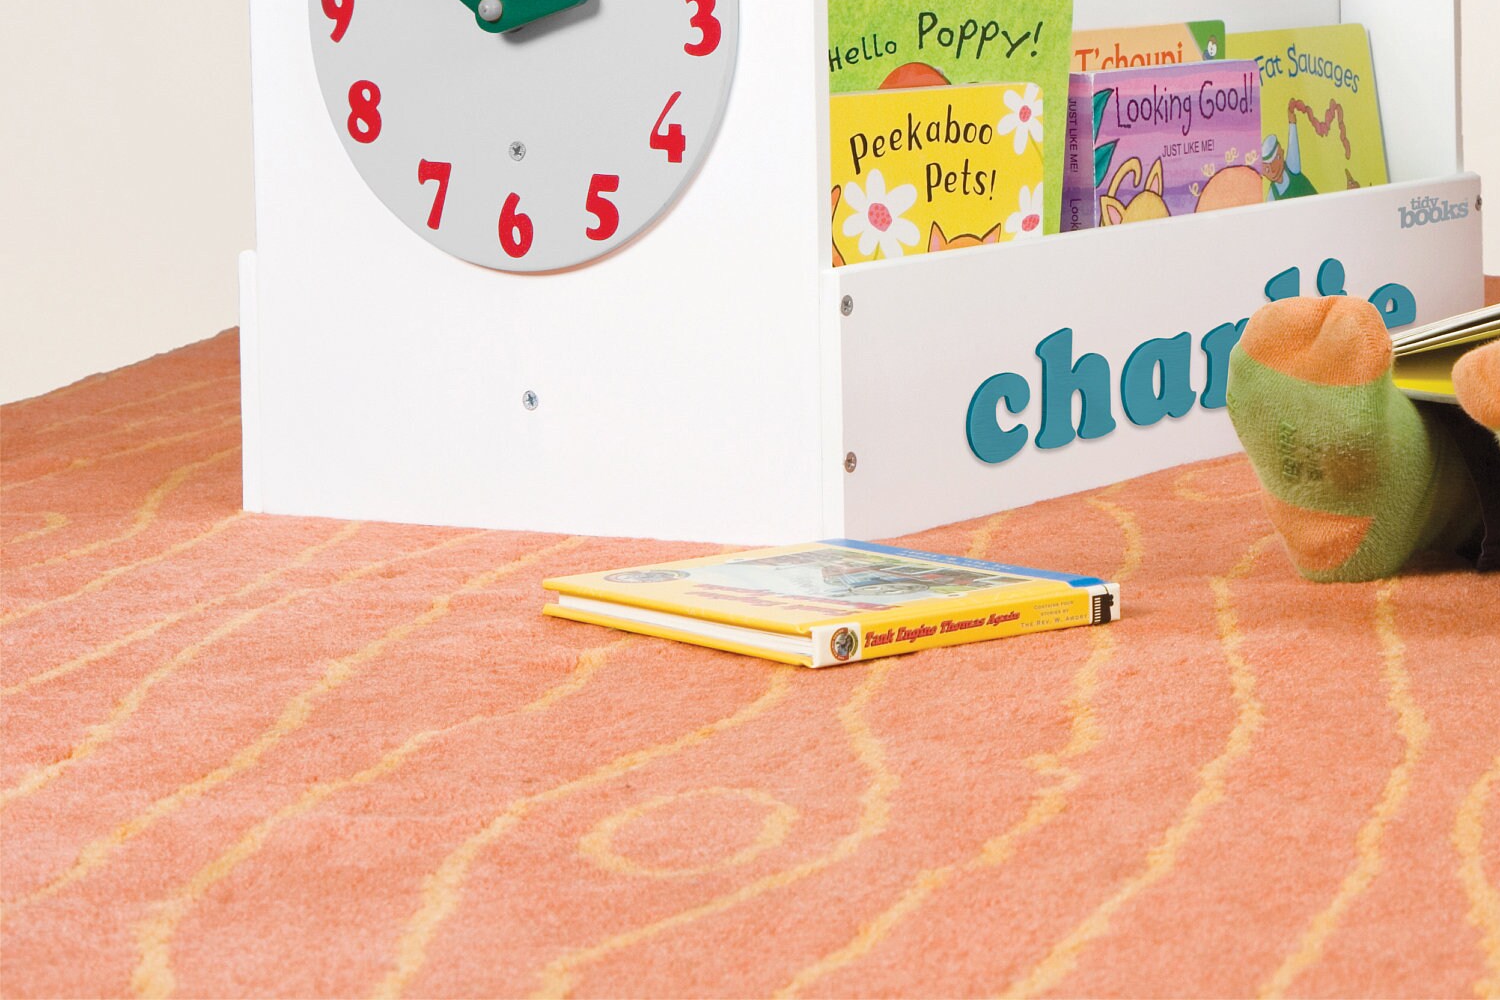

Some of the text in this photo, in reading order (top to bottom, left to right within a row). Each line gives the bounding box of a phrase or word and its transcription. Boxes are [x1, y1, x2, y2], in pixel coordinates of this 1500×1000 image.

[829, 11, 1044, 72] Hello Poppy!
[1254, 43, 1360, 93] Fat Sausages
[348, 80, 381, 143] 8
[650, 92, 686, 163] 4
[1115, 72, 1253, 136] Looking Good!
[1067, 99, 1079, 173] JUST LIKE ME!
[1162, 139, 1214, 157] JUST LIKE ME!
[418, 160, 451, 230] 7
[586, 174, 619, 240] 5
[926, 159, 996, 202] Pets!
[1410, 196, 1439, 211] tidy
[498, 193, 533, 258] 6
[1070, 198, 1082, 231] Look
[1398, 200, 1468, 228] books
[966, 258, 1417, 464] chare
[864, 629, 894, 648] Tank
[897, 618, 938, 643] Engine
[940, 615, 986, 635] Thomas
[986, 610, 1020, 626] Again
